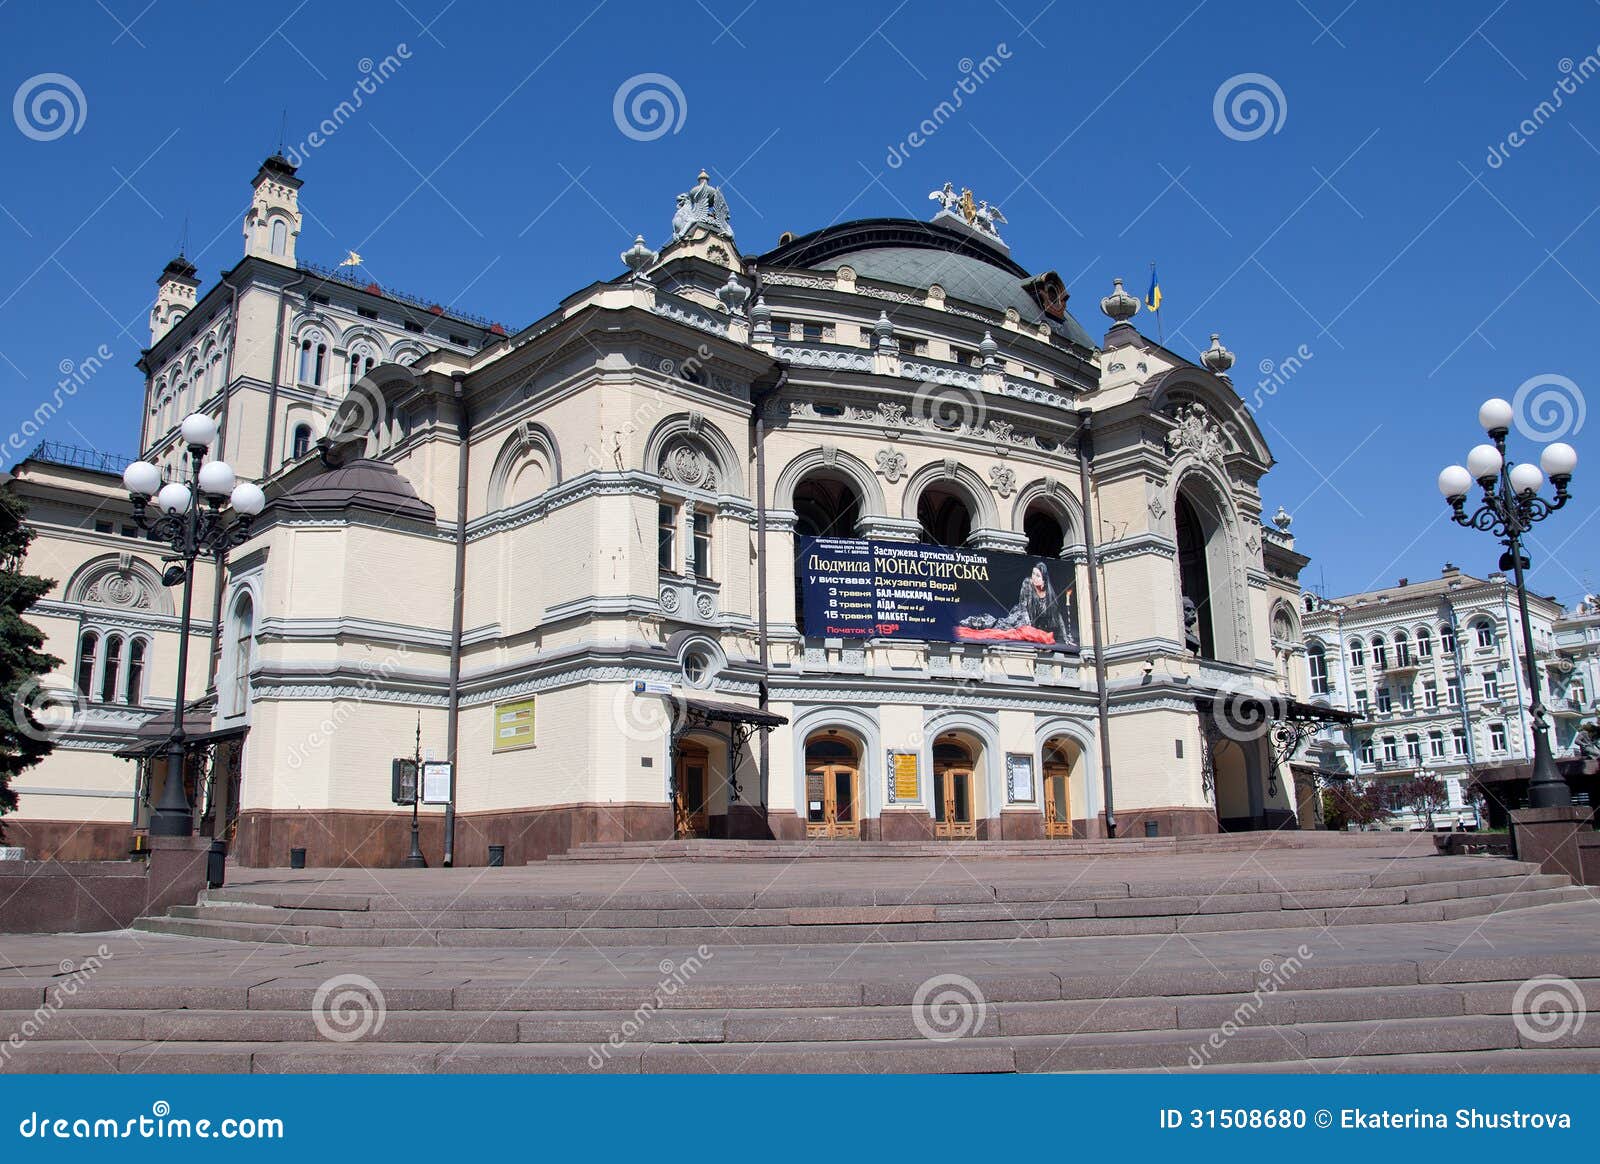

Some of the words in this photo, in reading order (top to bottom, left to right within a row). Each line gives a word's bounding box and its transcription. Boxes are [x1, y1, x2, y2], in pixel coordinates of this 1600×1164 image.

[874, 546, 918, 558] Заслужена
[920, 551, 954, 561] артистка
[956, 553, 988, 565] України
[808, 555, 870, 573] Людмила
[874, 558, 989, 580] МОНАСТИРСЬКА
[810, 576, 816, 584] у
[819, 576, 871, 585] виставах
[875, 577, 927, 588] Джузеппе
[930, 581, 957, 591] Верді
[828, 588, 837, 596] 3
[876, 589, 933, 601] БАЛ-МАСКАРАД
[877, 599, 895, 610] АЇДА
[824, 610, 838, 618] 15
[877, 612, 908, 621] МАКБЕТ
